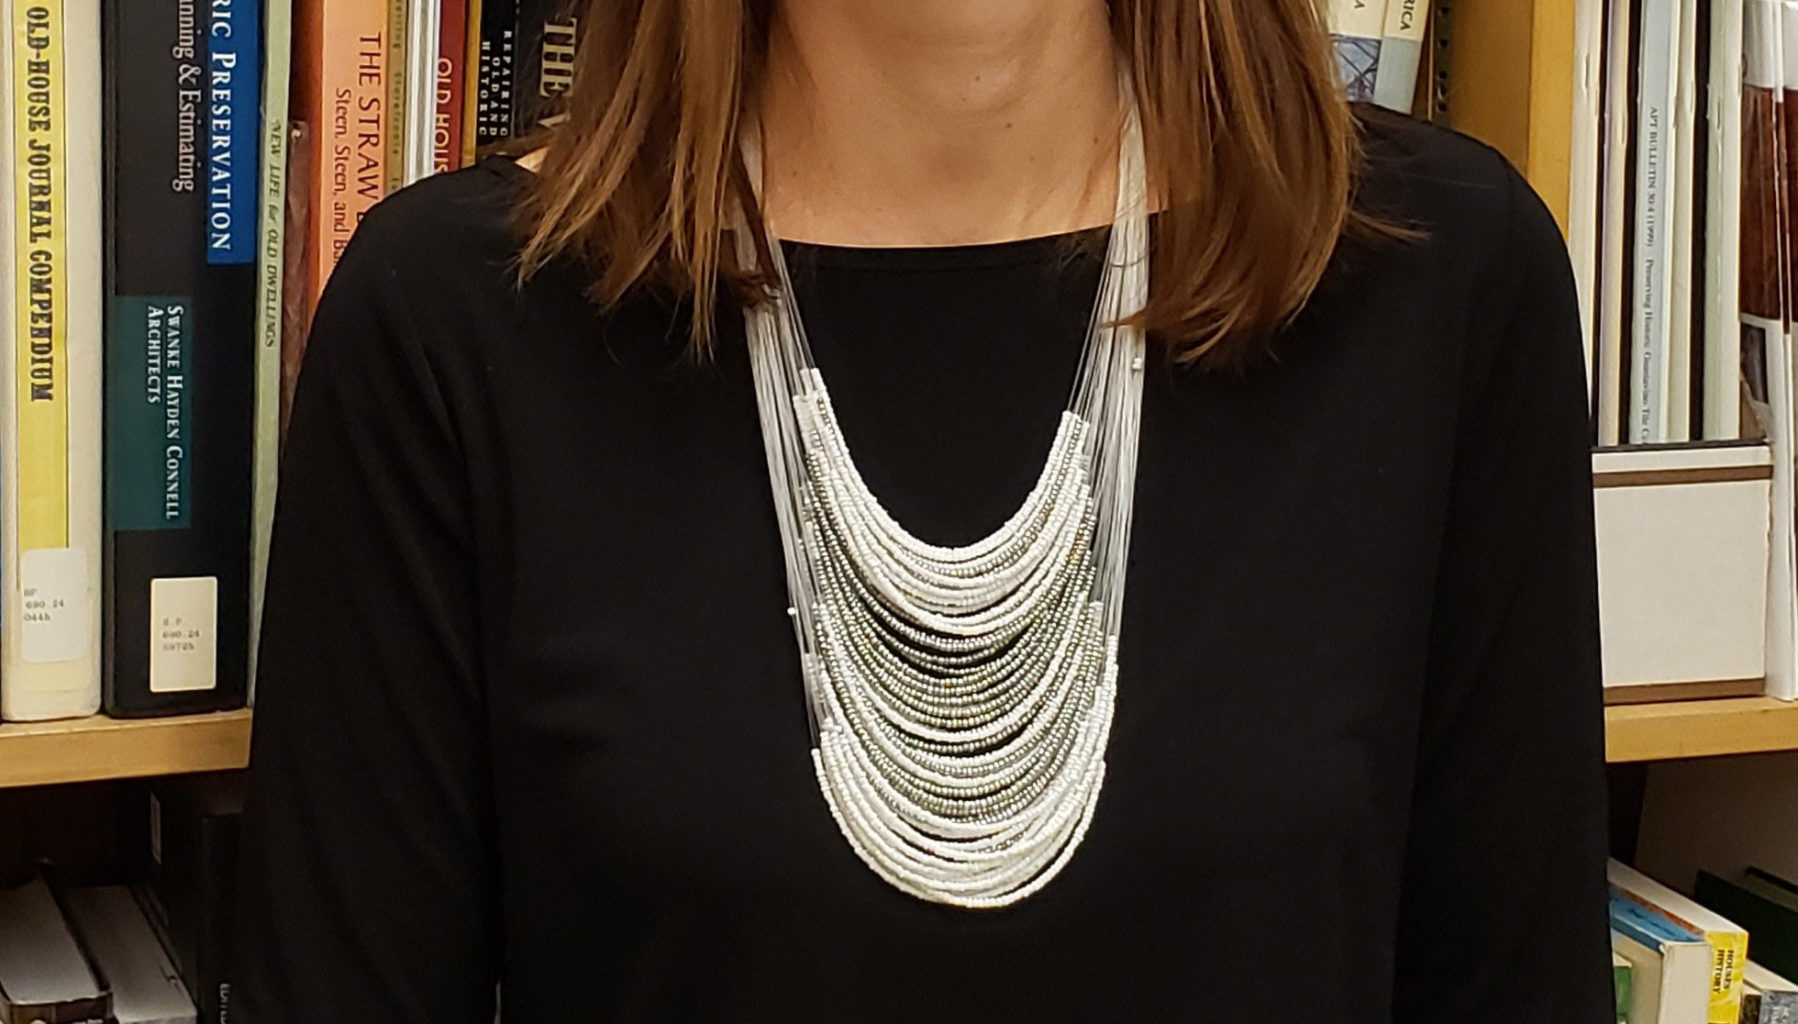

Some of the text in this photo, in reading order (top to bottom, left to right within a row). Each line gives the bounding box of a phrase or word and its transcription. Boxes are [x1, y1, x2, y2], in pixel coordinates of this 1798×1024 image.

[26, 6, 50, 132] OLD-HOUSE
[177, 63, 197, 84] &
[435, 57, 453, 104] OLD
[478, 40, 491, 136] HISTORIC
[488, 57, 502, 136] OLD AND
[499, 30, 513, 137] REPAIRING
[539, 17, 578, 98] THE
[173, 89, 202, 191] Estimating
[211, 51, 236, 250] PRESERVATION
[270, 119, 282, 156] NEW
[356, 32, 382, 200] THE STRAW
[1649, 106, 1659, 129] APT
[28, 138, 51, 243] JOURNAL
[268, 163, 281, 198] LIFE
[1647, 131, 1658, 189] BULLETIN
[266, 228, 279, 258] OLD
[332, 201, 349, 231] and
[264, 264, 278, 349] DWELLINGS
[1642, 258, 1654, 308] Preserving
[28, 249, 53, 402] COMPENDIUM
[147, 305, 163, 404] ARCHITECTS
[165, 305, 184, 519] SWANKE HAYDEN CONNELL
